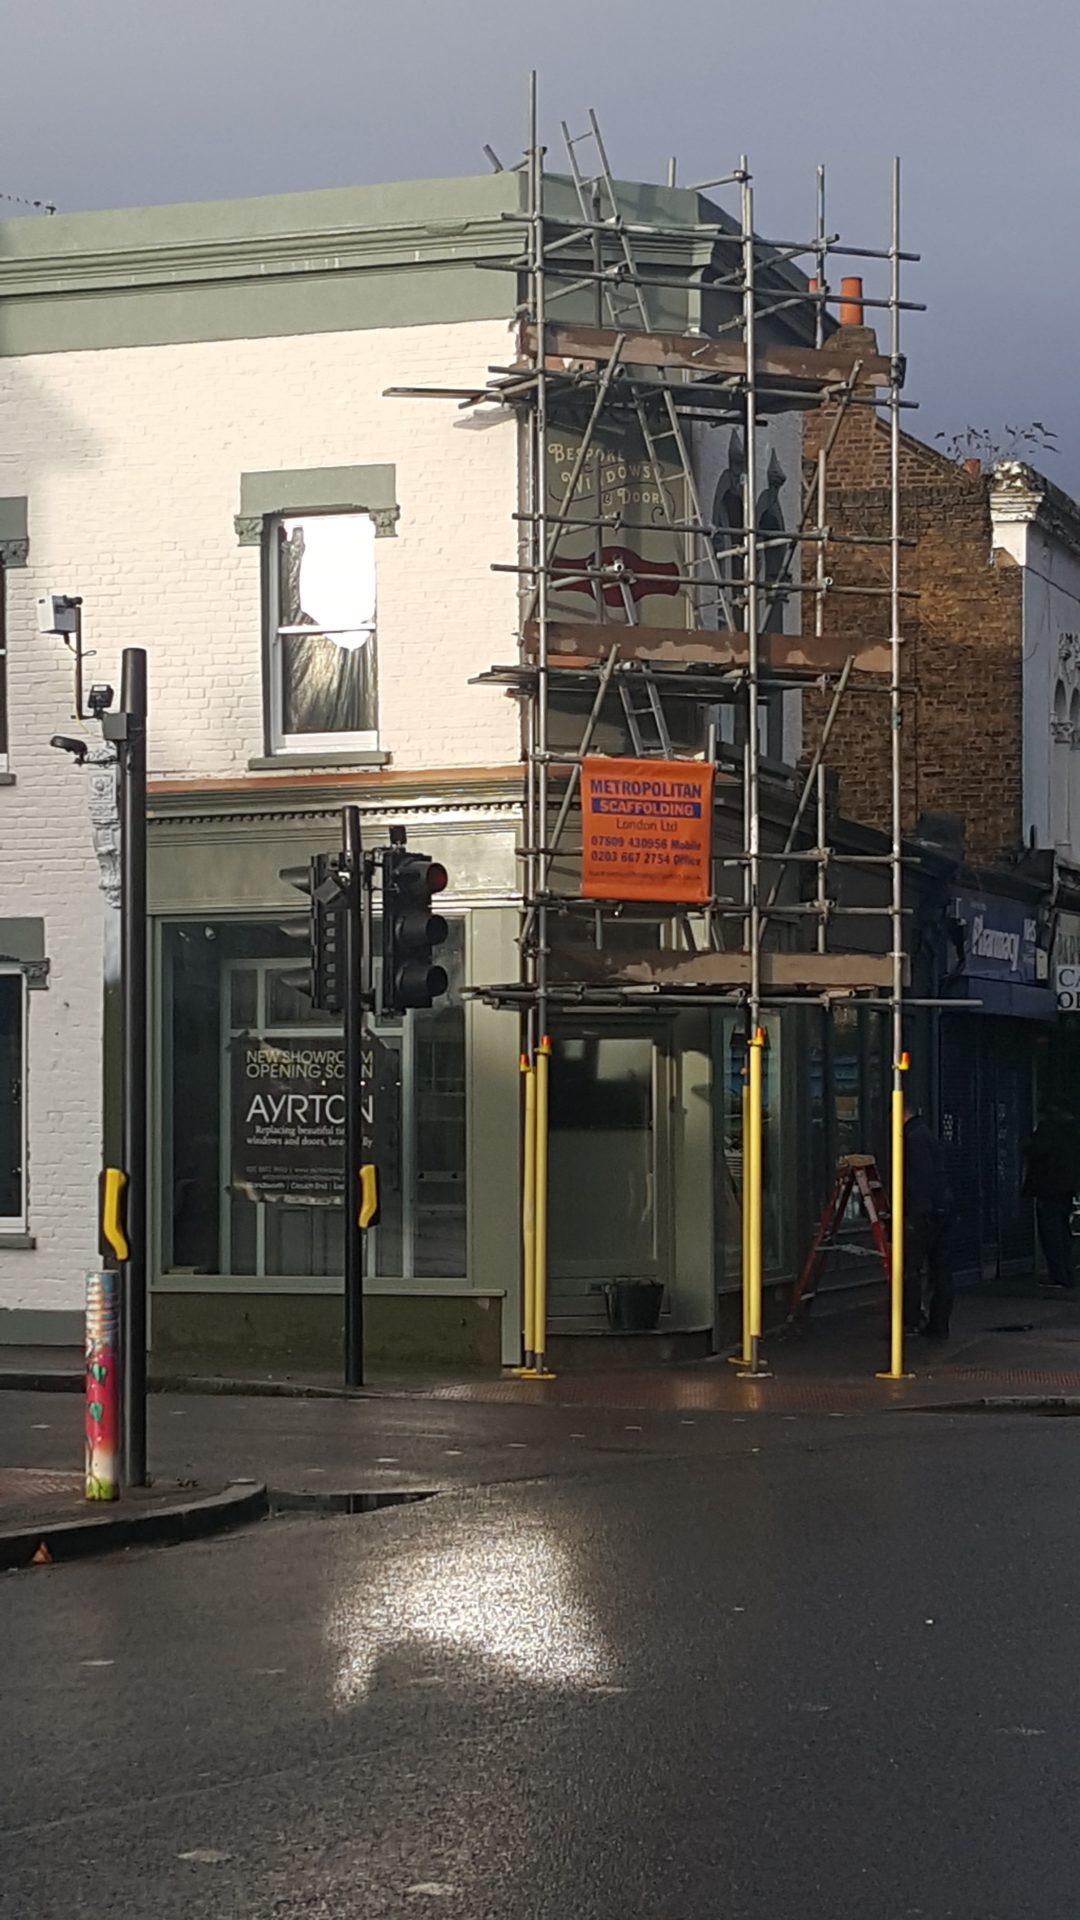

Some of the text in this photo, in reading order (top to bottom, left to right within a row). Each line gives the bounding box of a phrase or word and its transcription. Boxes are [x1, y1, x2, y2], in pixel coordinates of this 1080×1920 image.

[561, 464, 650, 493] WIDOWS
[591, 779, 702, 798] METROPOLITAN
[600, 801, 694, 816] SCAFFOLDING
[616, 818, 677, 832] London Ltd
[591, 850, 618, 862] 0203
[620, 852, 640, 863] 667
[643, 852, 670, 865] 2754
[246, 1050, 373, 1064] NEW SHOWROM
[246, 1064, 373, 1078] OPENING SON
[284, 1136, 300, 1145] and
